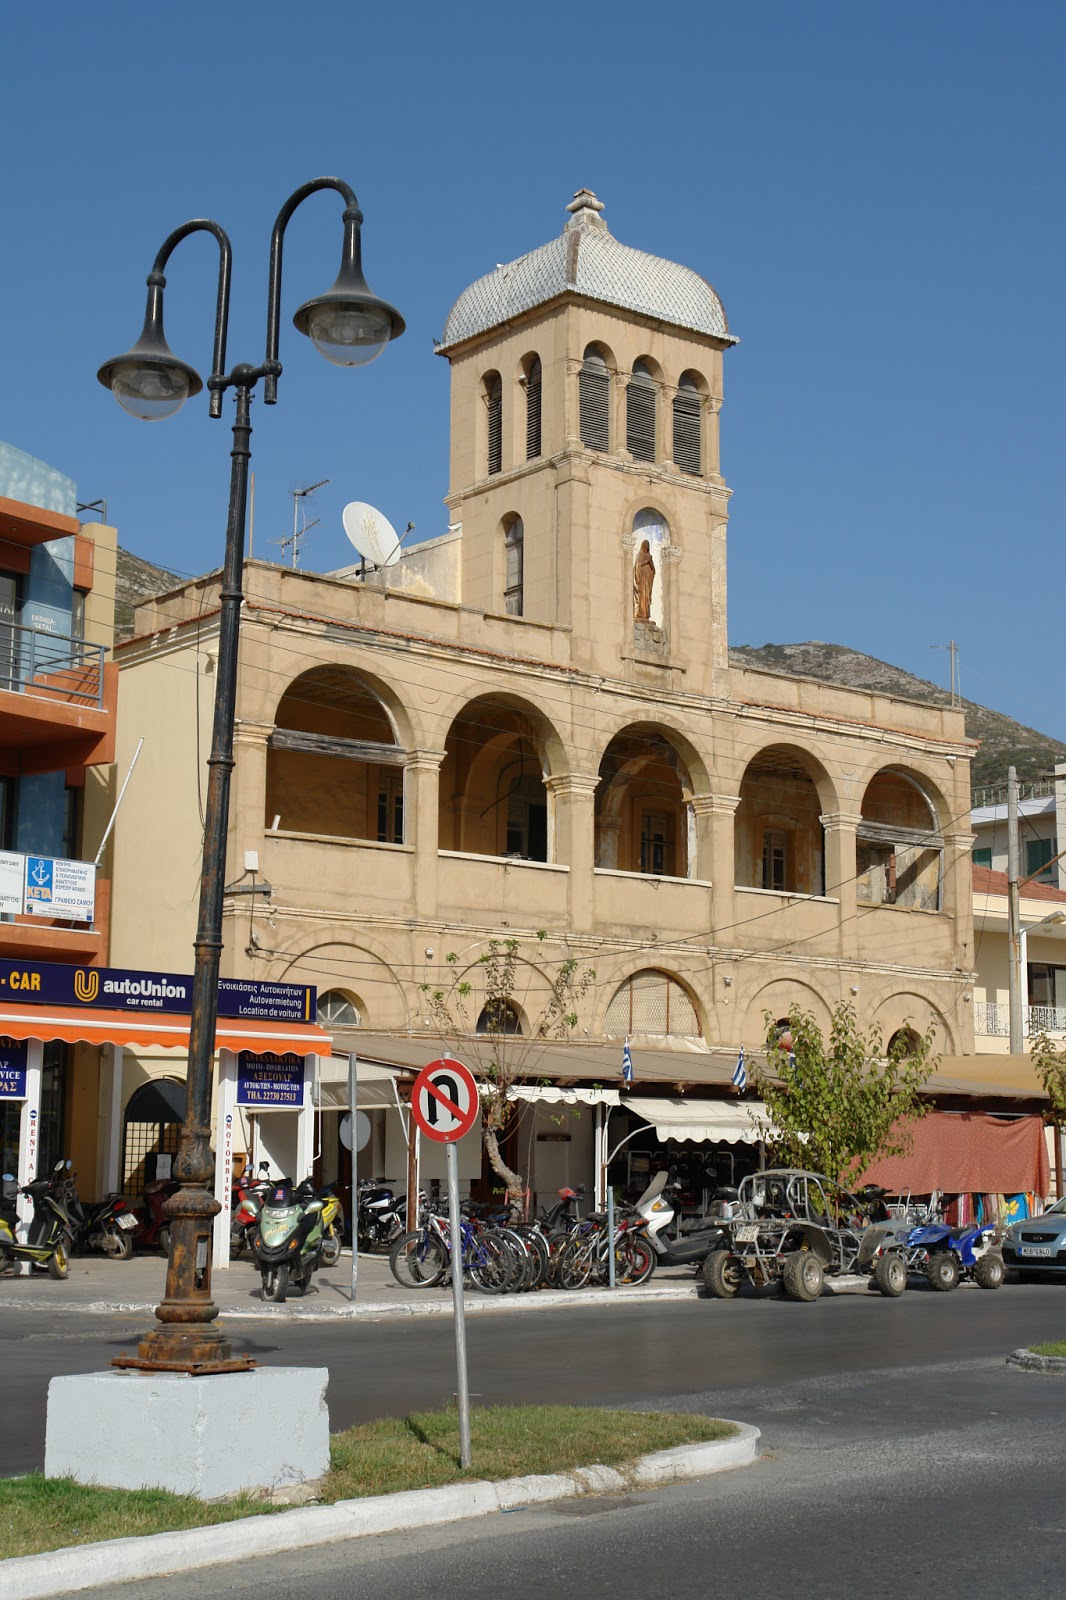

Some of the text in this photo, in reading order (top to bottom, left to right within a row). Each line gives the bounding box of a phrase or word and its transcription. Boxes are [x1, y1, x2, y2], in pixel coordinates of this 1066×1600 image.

[9, 971, 41, 991] CAR
[103, 978, 186, 999] autoUnion
[217, 981, 302, 997] Ενοικιάσεις Αυτοκινήτων
[141, 999, 163, 1007] rental
[249, 995, 302, 1009] Autovermietung
[239, 1005, 302, 1018] Location de voiture
